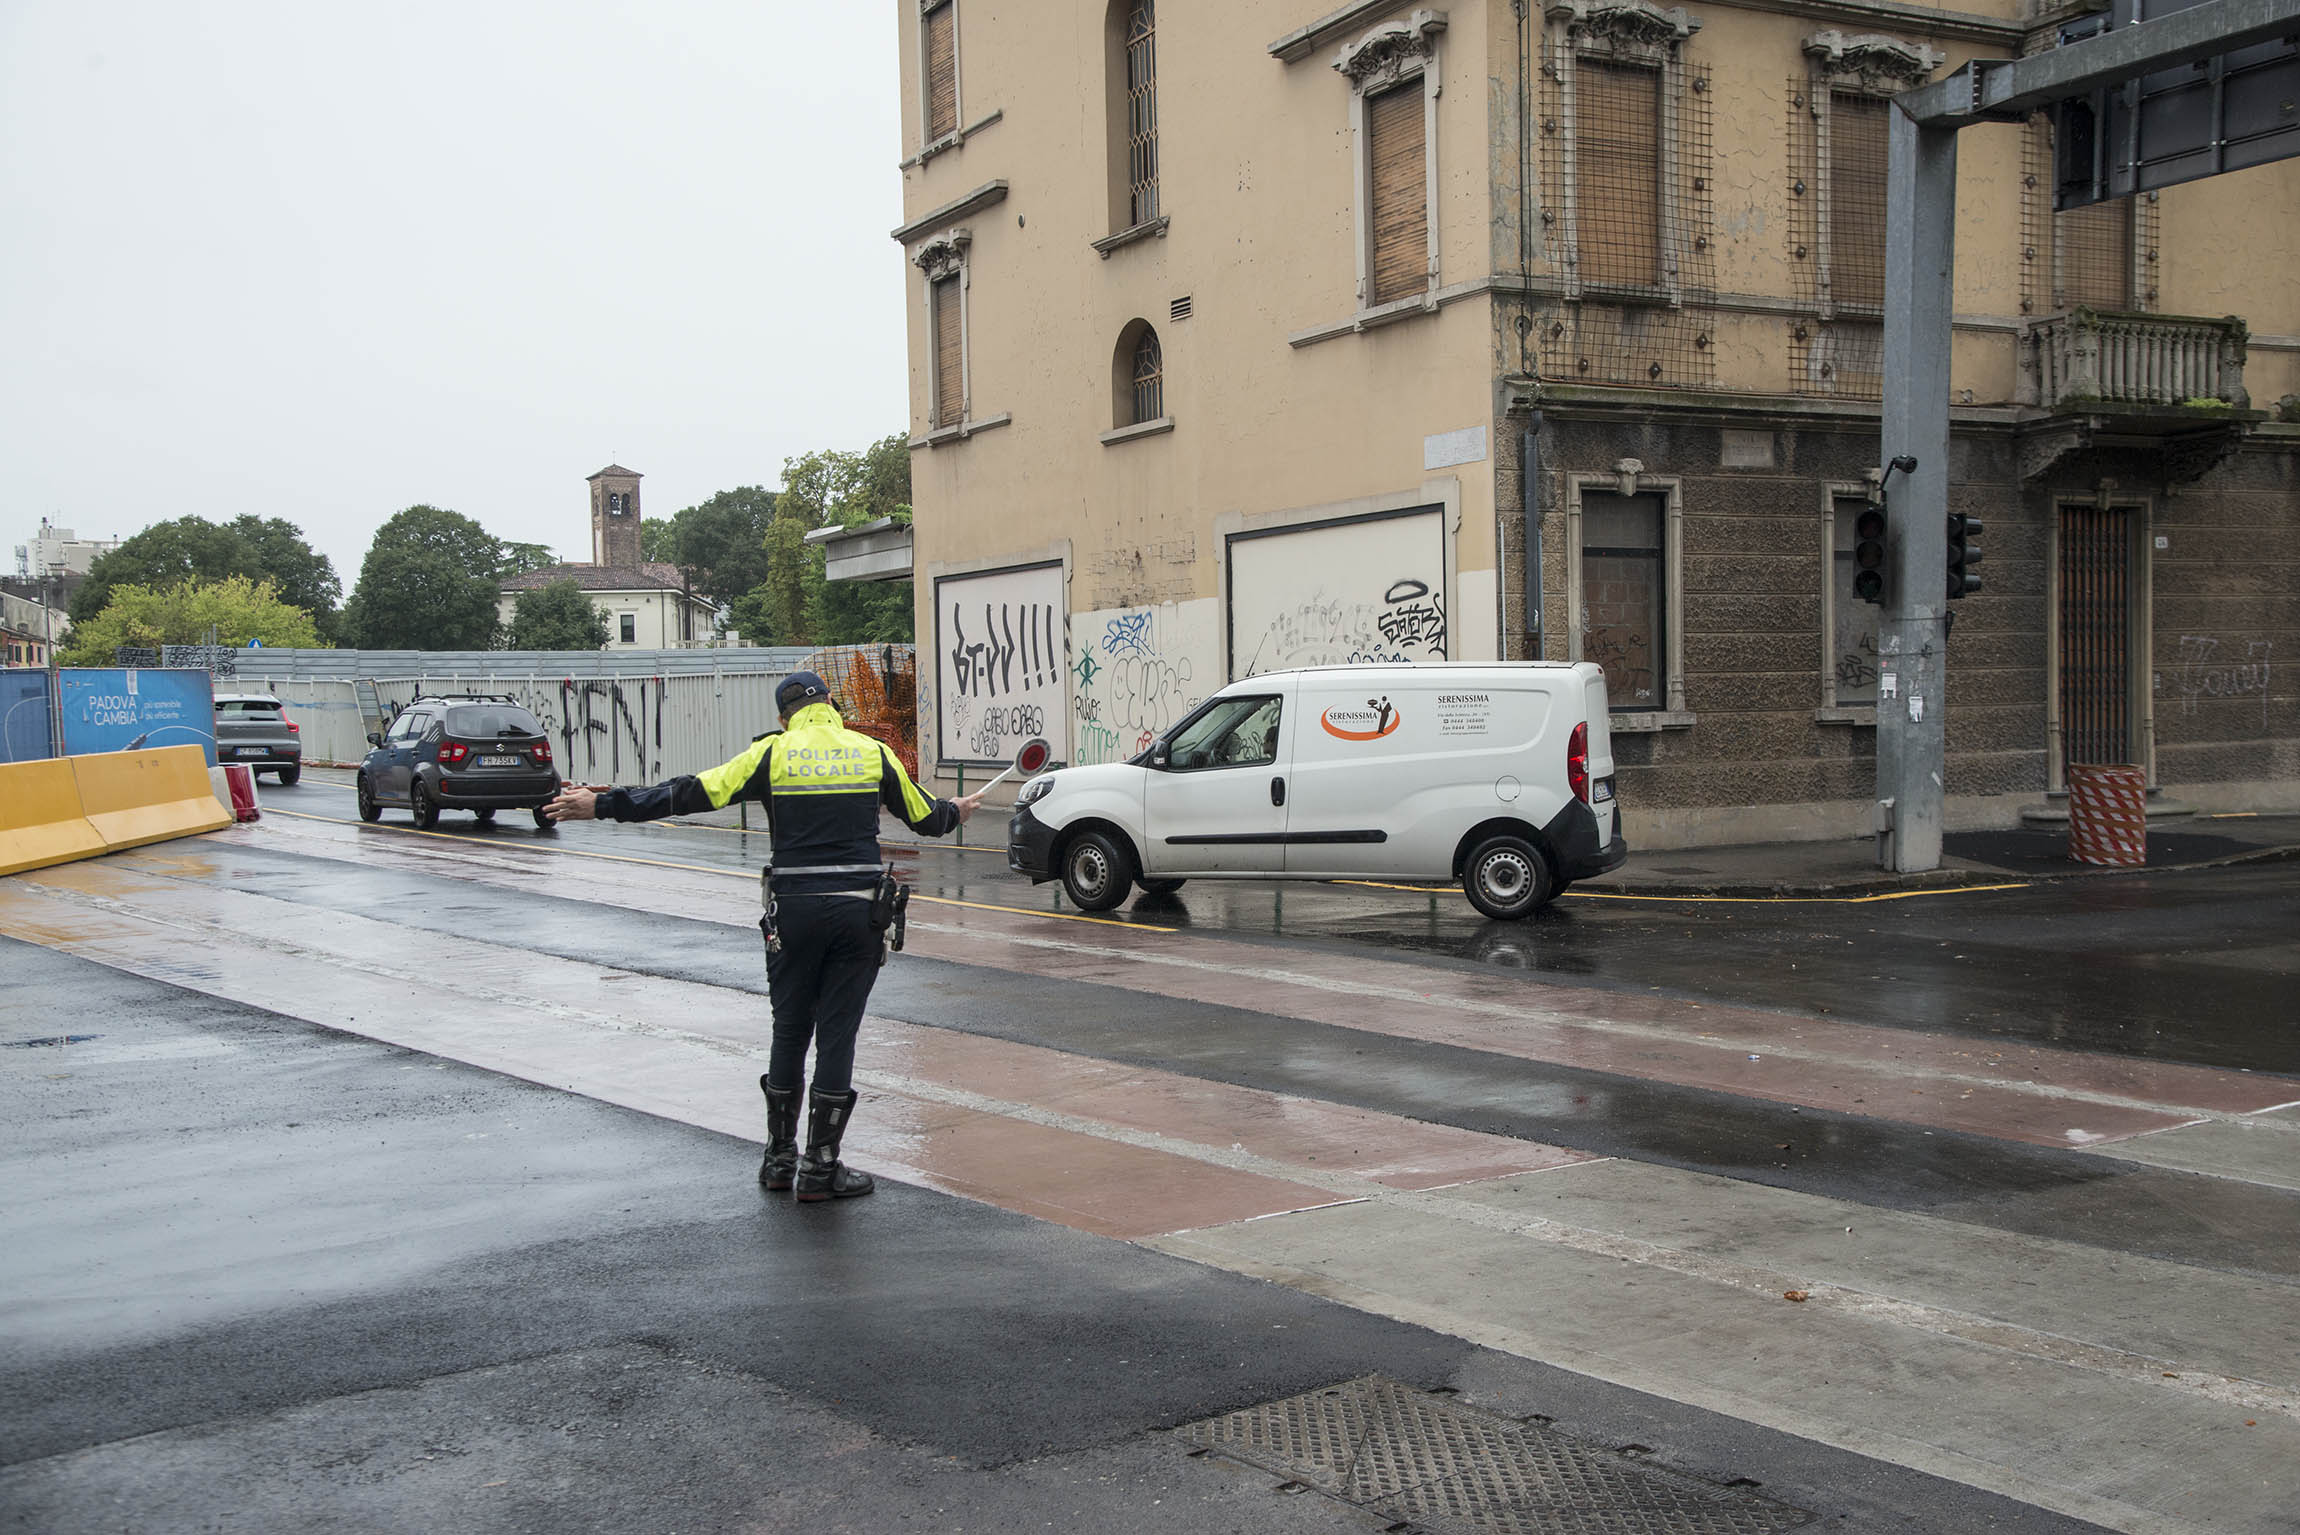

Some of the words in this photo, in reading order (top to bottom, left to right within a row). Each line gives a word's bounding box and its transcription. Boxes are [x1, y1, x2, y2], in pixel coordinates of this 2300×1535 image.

[88, 695, 137, 710] PADOVA
[1438, 694, 1489, 703] SERENISSIMA
[94, 711, 138, 726] CAMBIA
[1329, 711, 1378, 720] SERENISSIMA
[787, 748, 864, 761] POLIZIA
[787, 763, 865, 777] LOCALE
